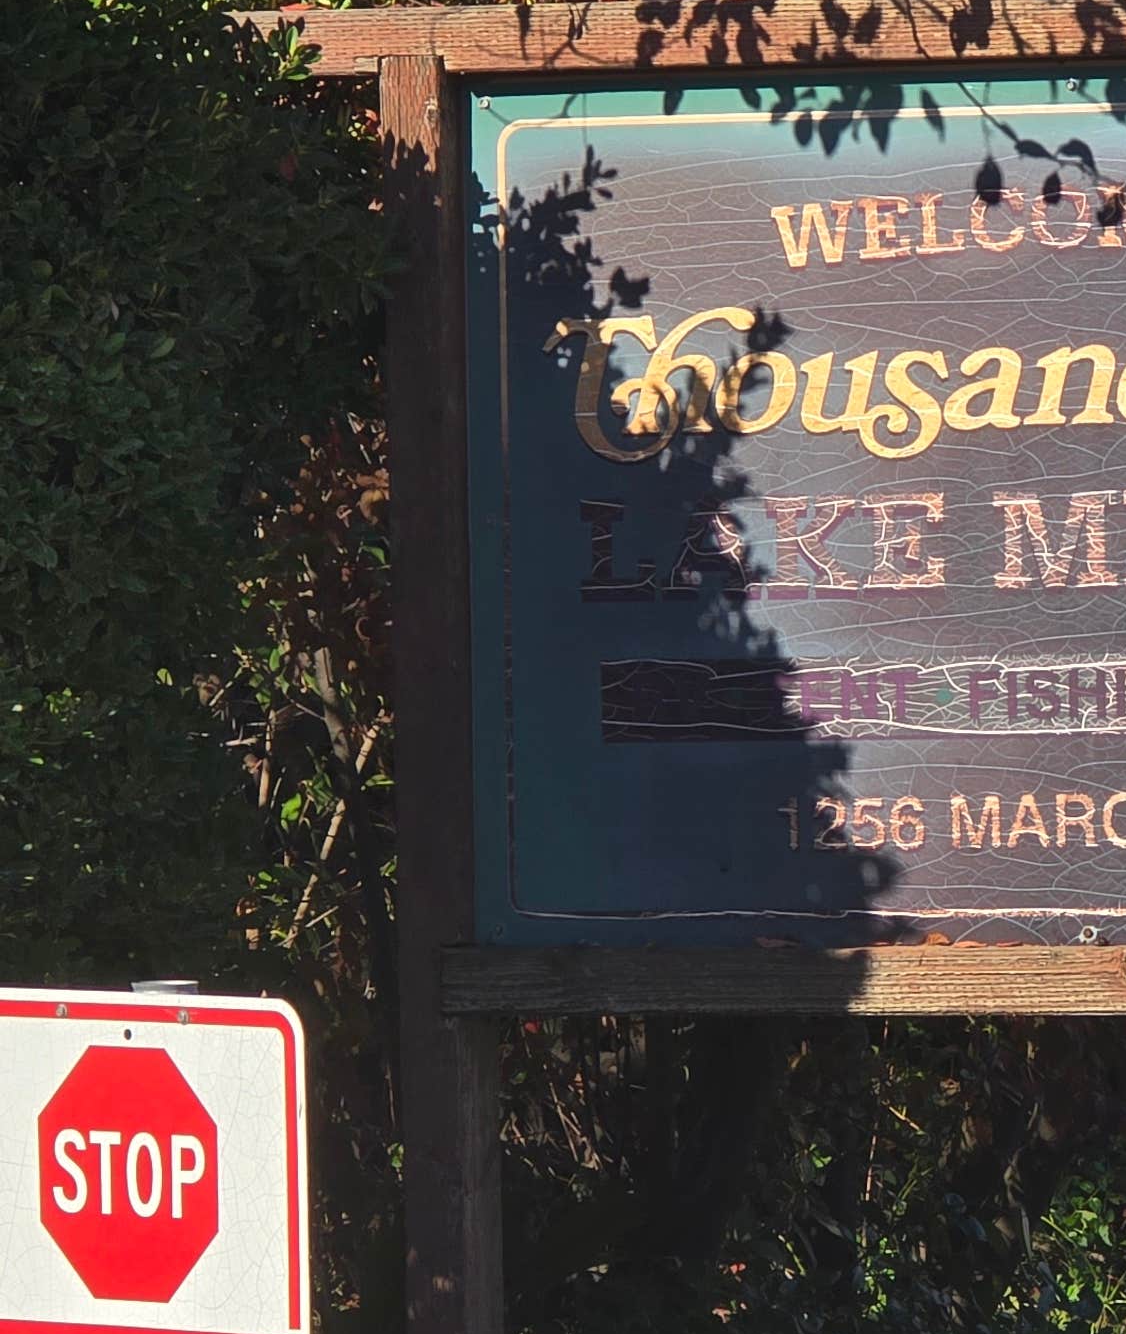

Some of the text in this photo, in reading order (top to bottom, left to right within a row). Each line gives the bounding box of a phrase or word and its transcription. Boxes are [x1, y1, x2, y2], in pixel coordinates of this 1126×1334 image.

[580, 492, 946, 601] LAKE
[778, 795, 925, 851] 1256
[52, 1128, 206, 1219] STOP
